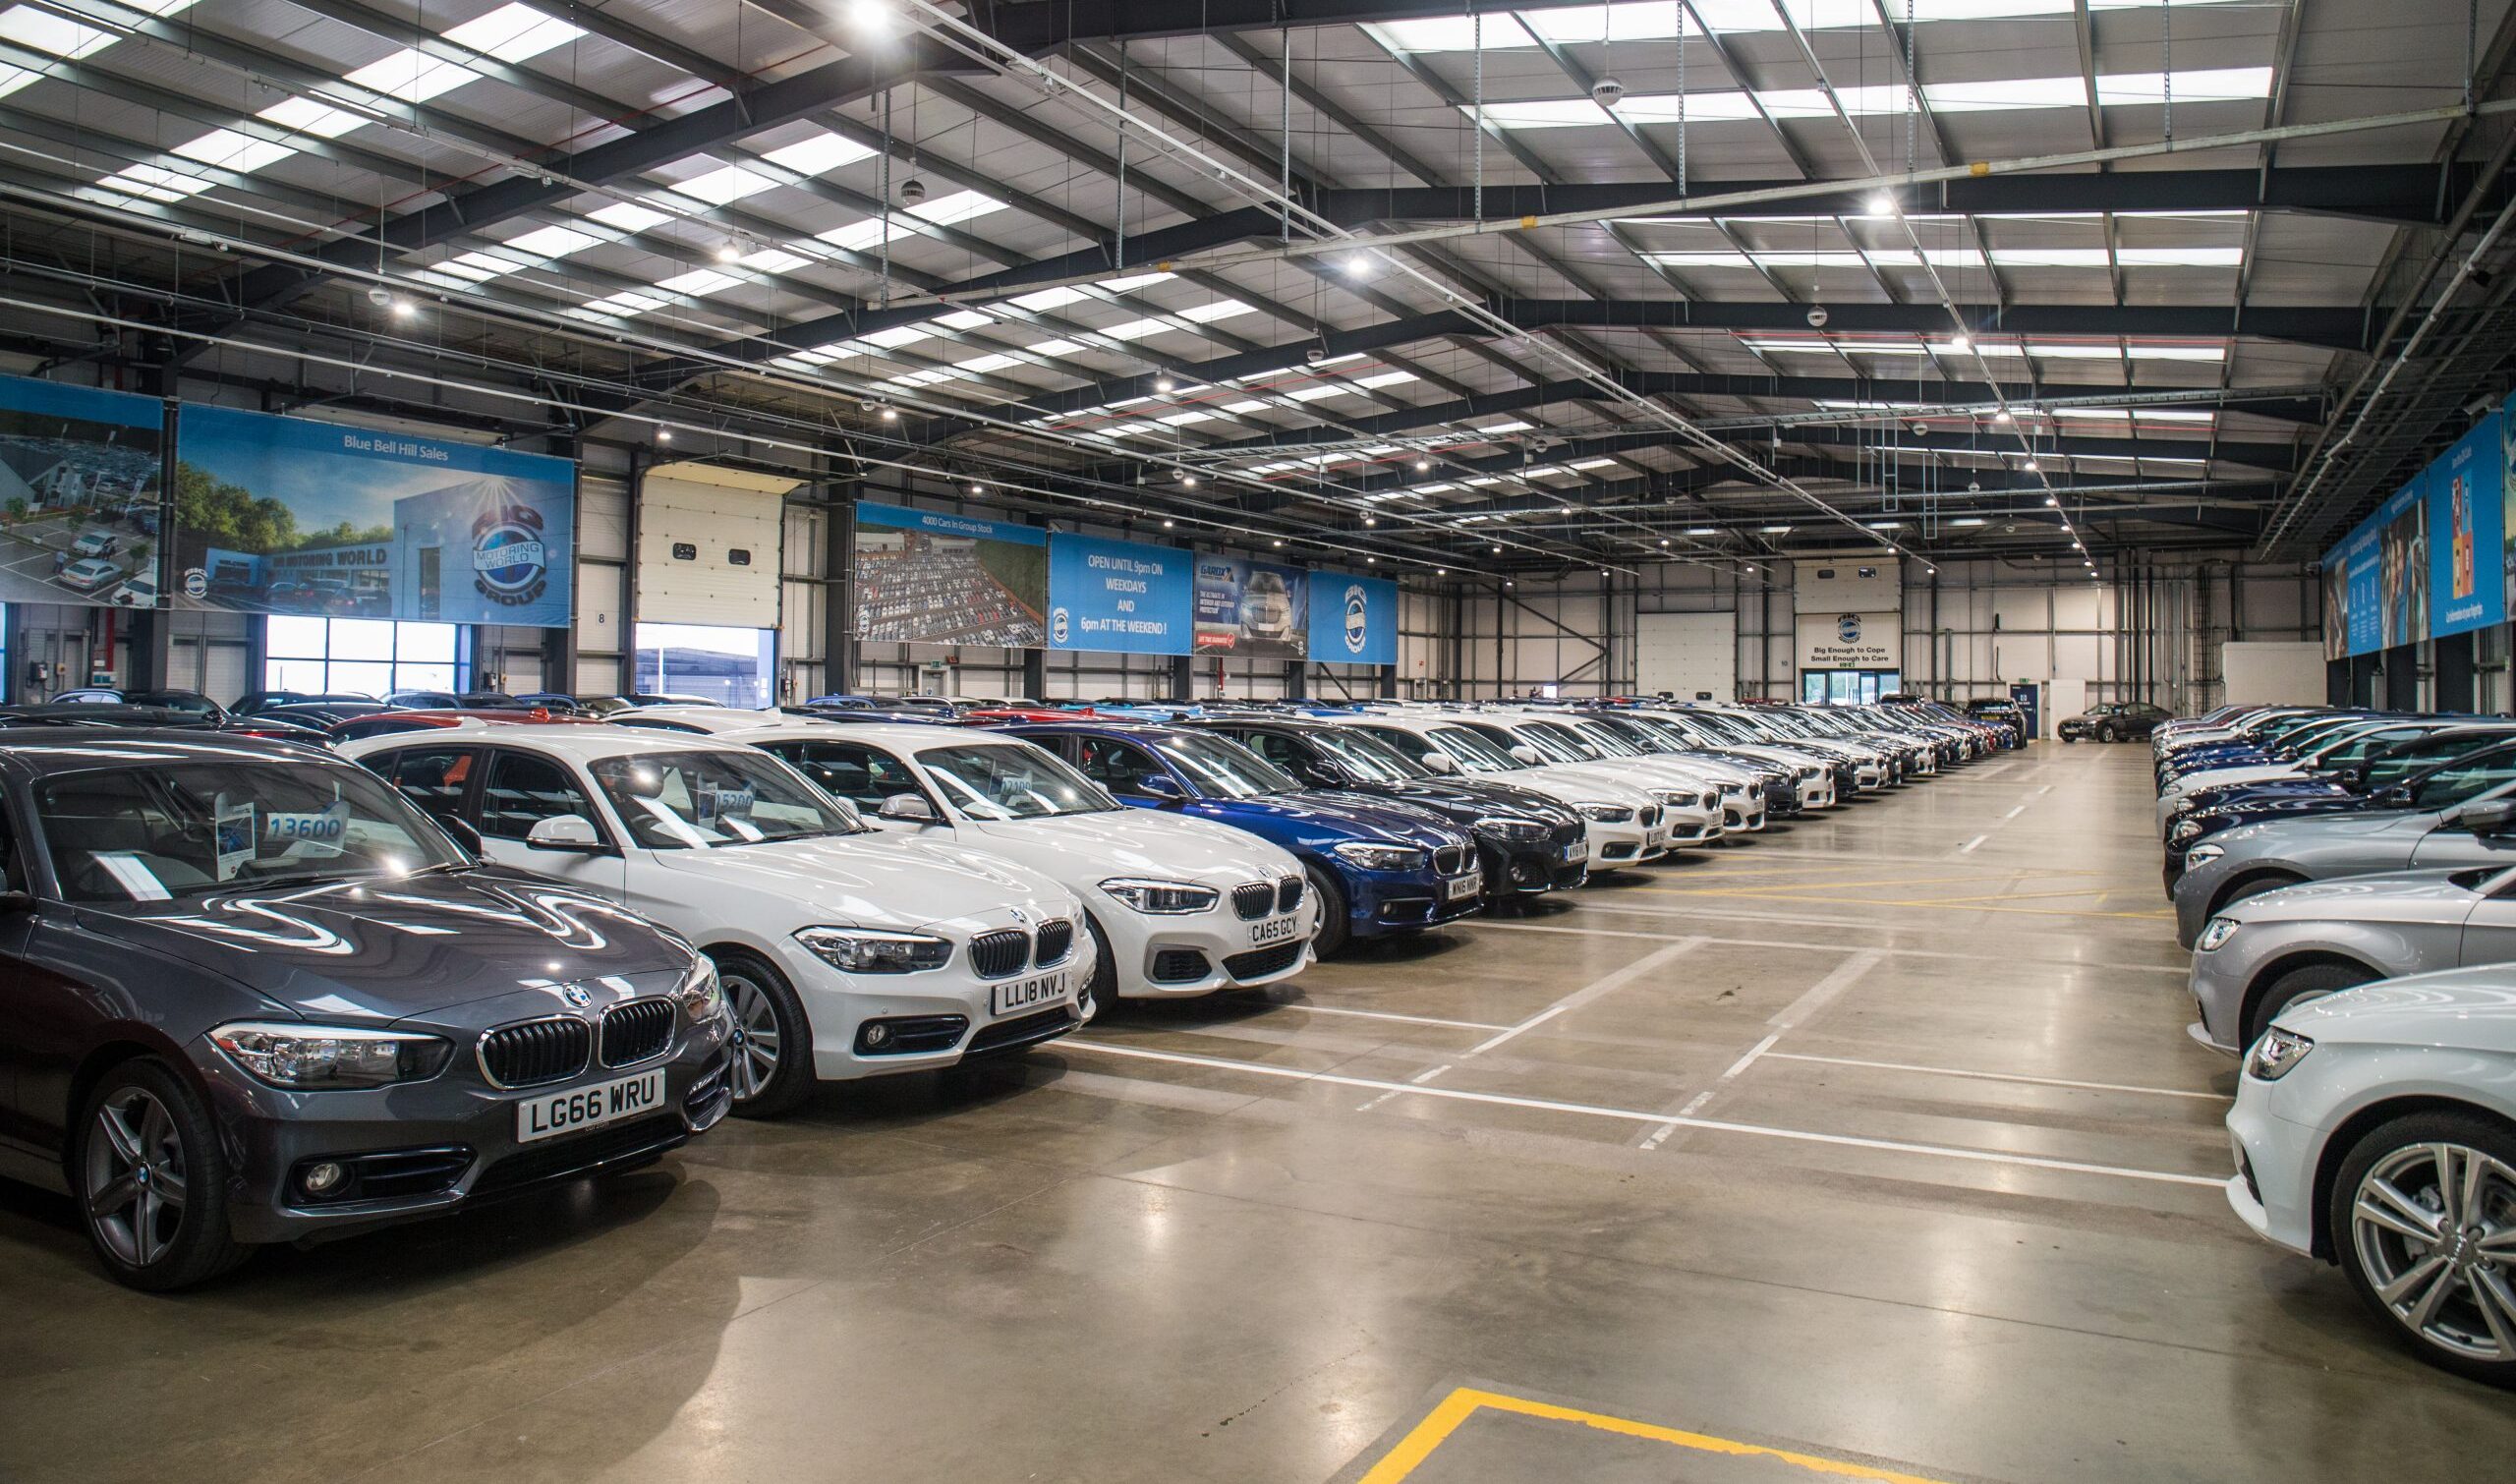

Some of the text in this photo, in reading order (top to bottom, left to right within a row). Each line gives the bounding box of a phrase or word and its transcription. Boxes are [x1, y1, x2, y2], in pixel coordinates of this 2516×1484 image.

[344, 434, 448, 461] Blue Bell Hill Sales
[922, 516, 993, 534] 4000 Cars In Group Stock
[286, 552, 332, 567] MOTORING
[337, 547, 387, 566] WORLD
[476, 542, 540, 561] MOTORING
[485, 552, 530, 569] WORLD
[1088, 554, 1163, 576] OPEN UNTIL 9pm ON
[474, 579, 546, 605] GROUP
[1106, 578, 1147, 594] WEEKDAYS
[1117, 599, 1135, 612] AND
[599, 613, 604, 624] 8
[1081, 617, 1099, 632] 6pm
[1100, 618, 1111, 630] AT
[1111, 619, 1126, 632] THE
[1127, 620, 1163, 634] WEEKEND
[270, 818, 341, 837] 13600
[1252, 915, 1297, 942] CA65 GCY
[1005, 973, 1065, 1007] LL18 NVJ
[532, 1075, 656, 1133] LG66 WRU
